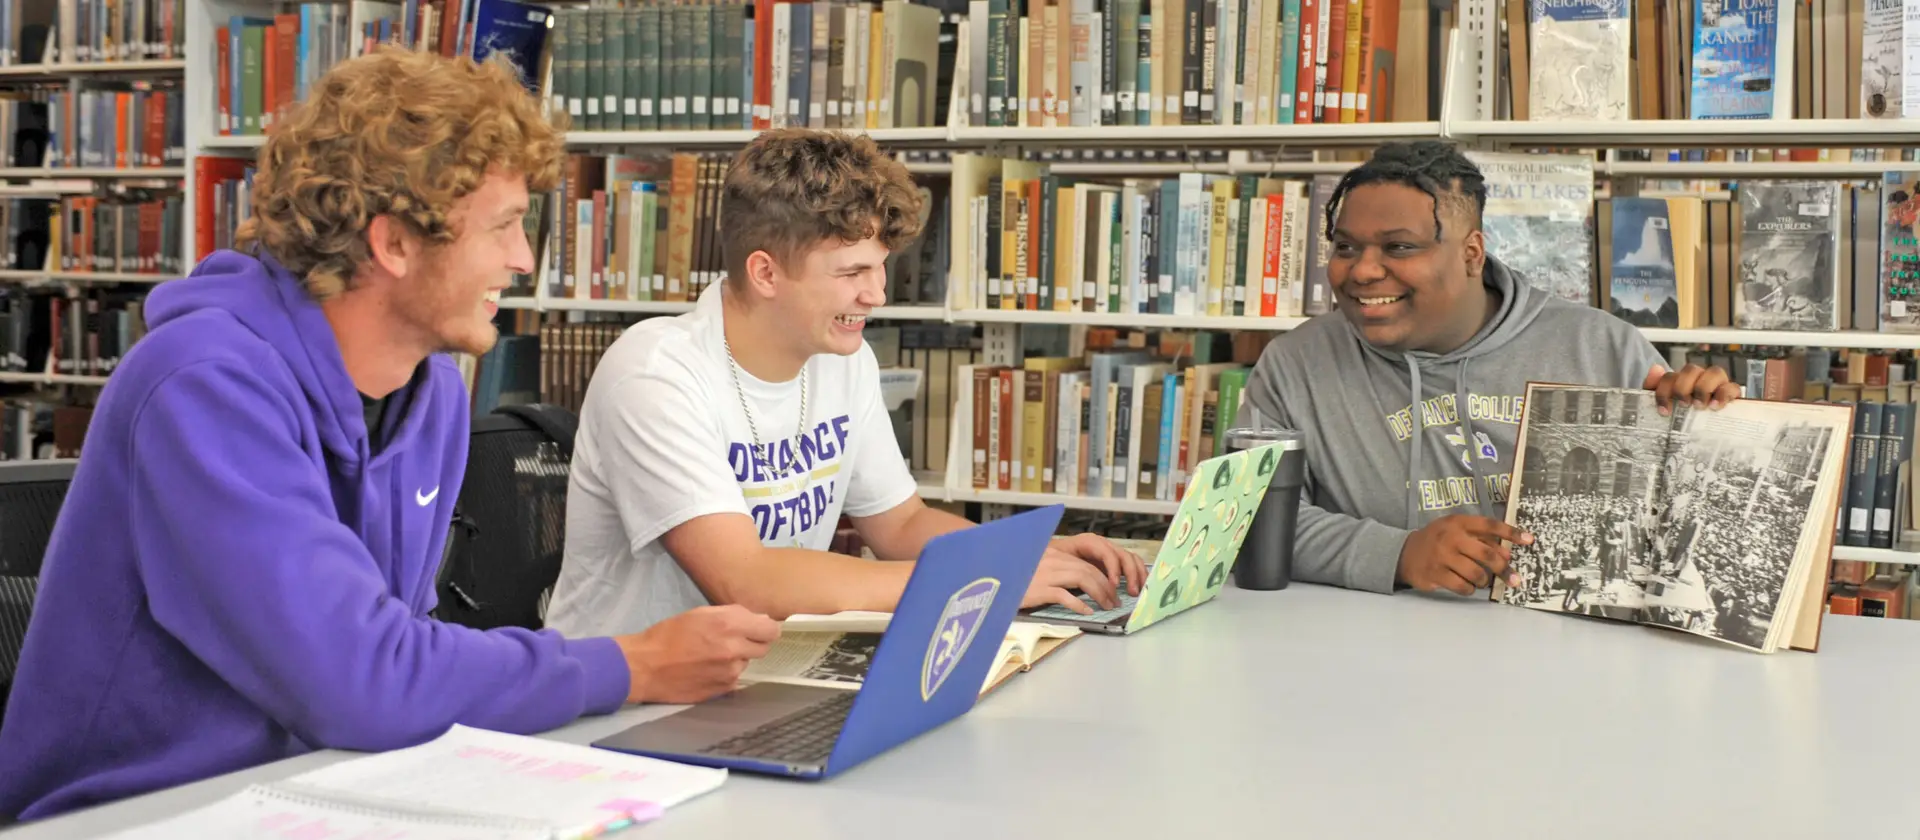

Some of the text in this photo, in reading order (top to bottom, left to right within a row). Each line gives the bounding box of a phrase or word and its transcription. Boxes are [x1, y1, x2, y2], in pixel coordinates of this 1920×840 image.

[1700, 29, 1755, 45] RANGE
[1485, 184, 1588, 200] REAT LAKES
[1758, 222, 1812, 231] EXPLORERS
[1281, 251, 1290, 289] WOMA
[1387, 394, 1524, 440] DEANC COLLE
[751, 481, 834, 540] OFTBA
[1406, 477, 1479, 511] ELLOW
